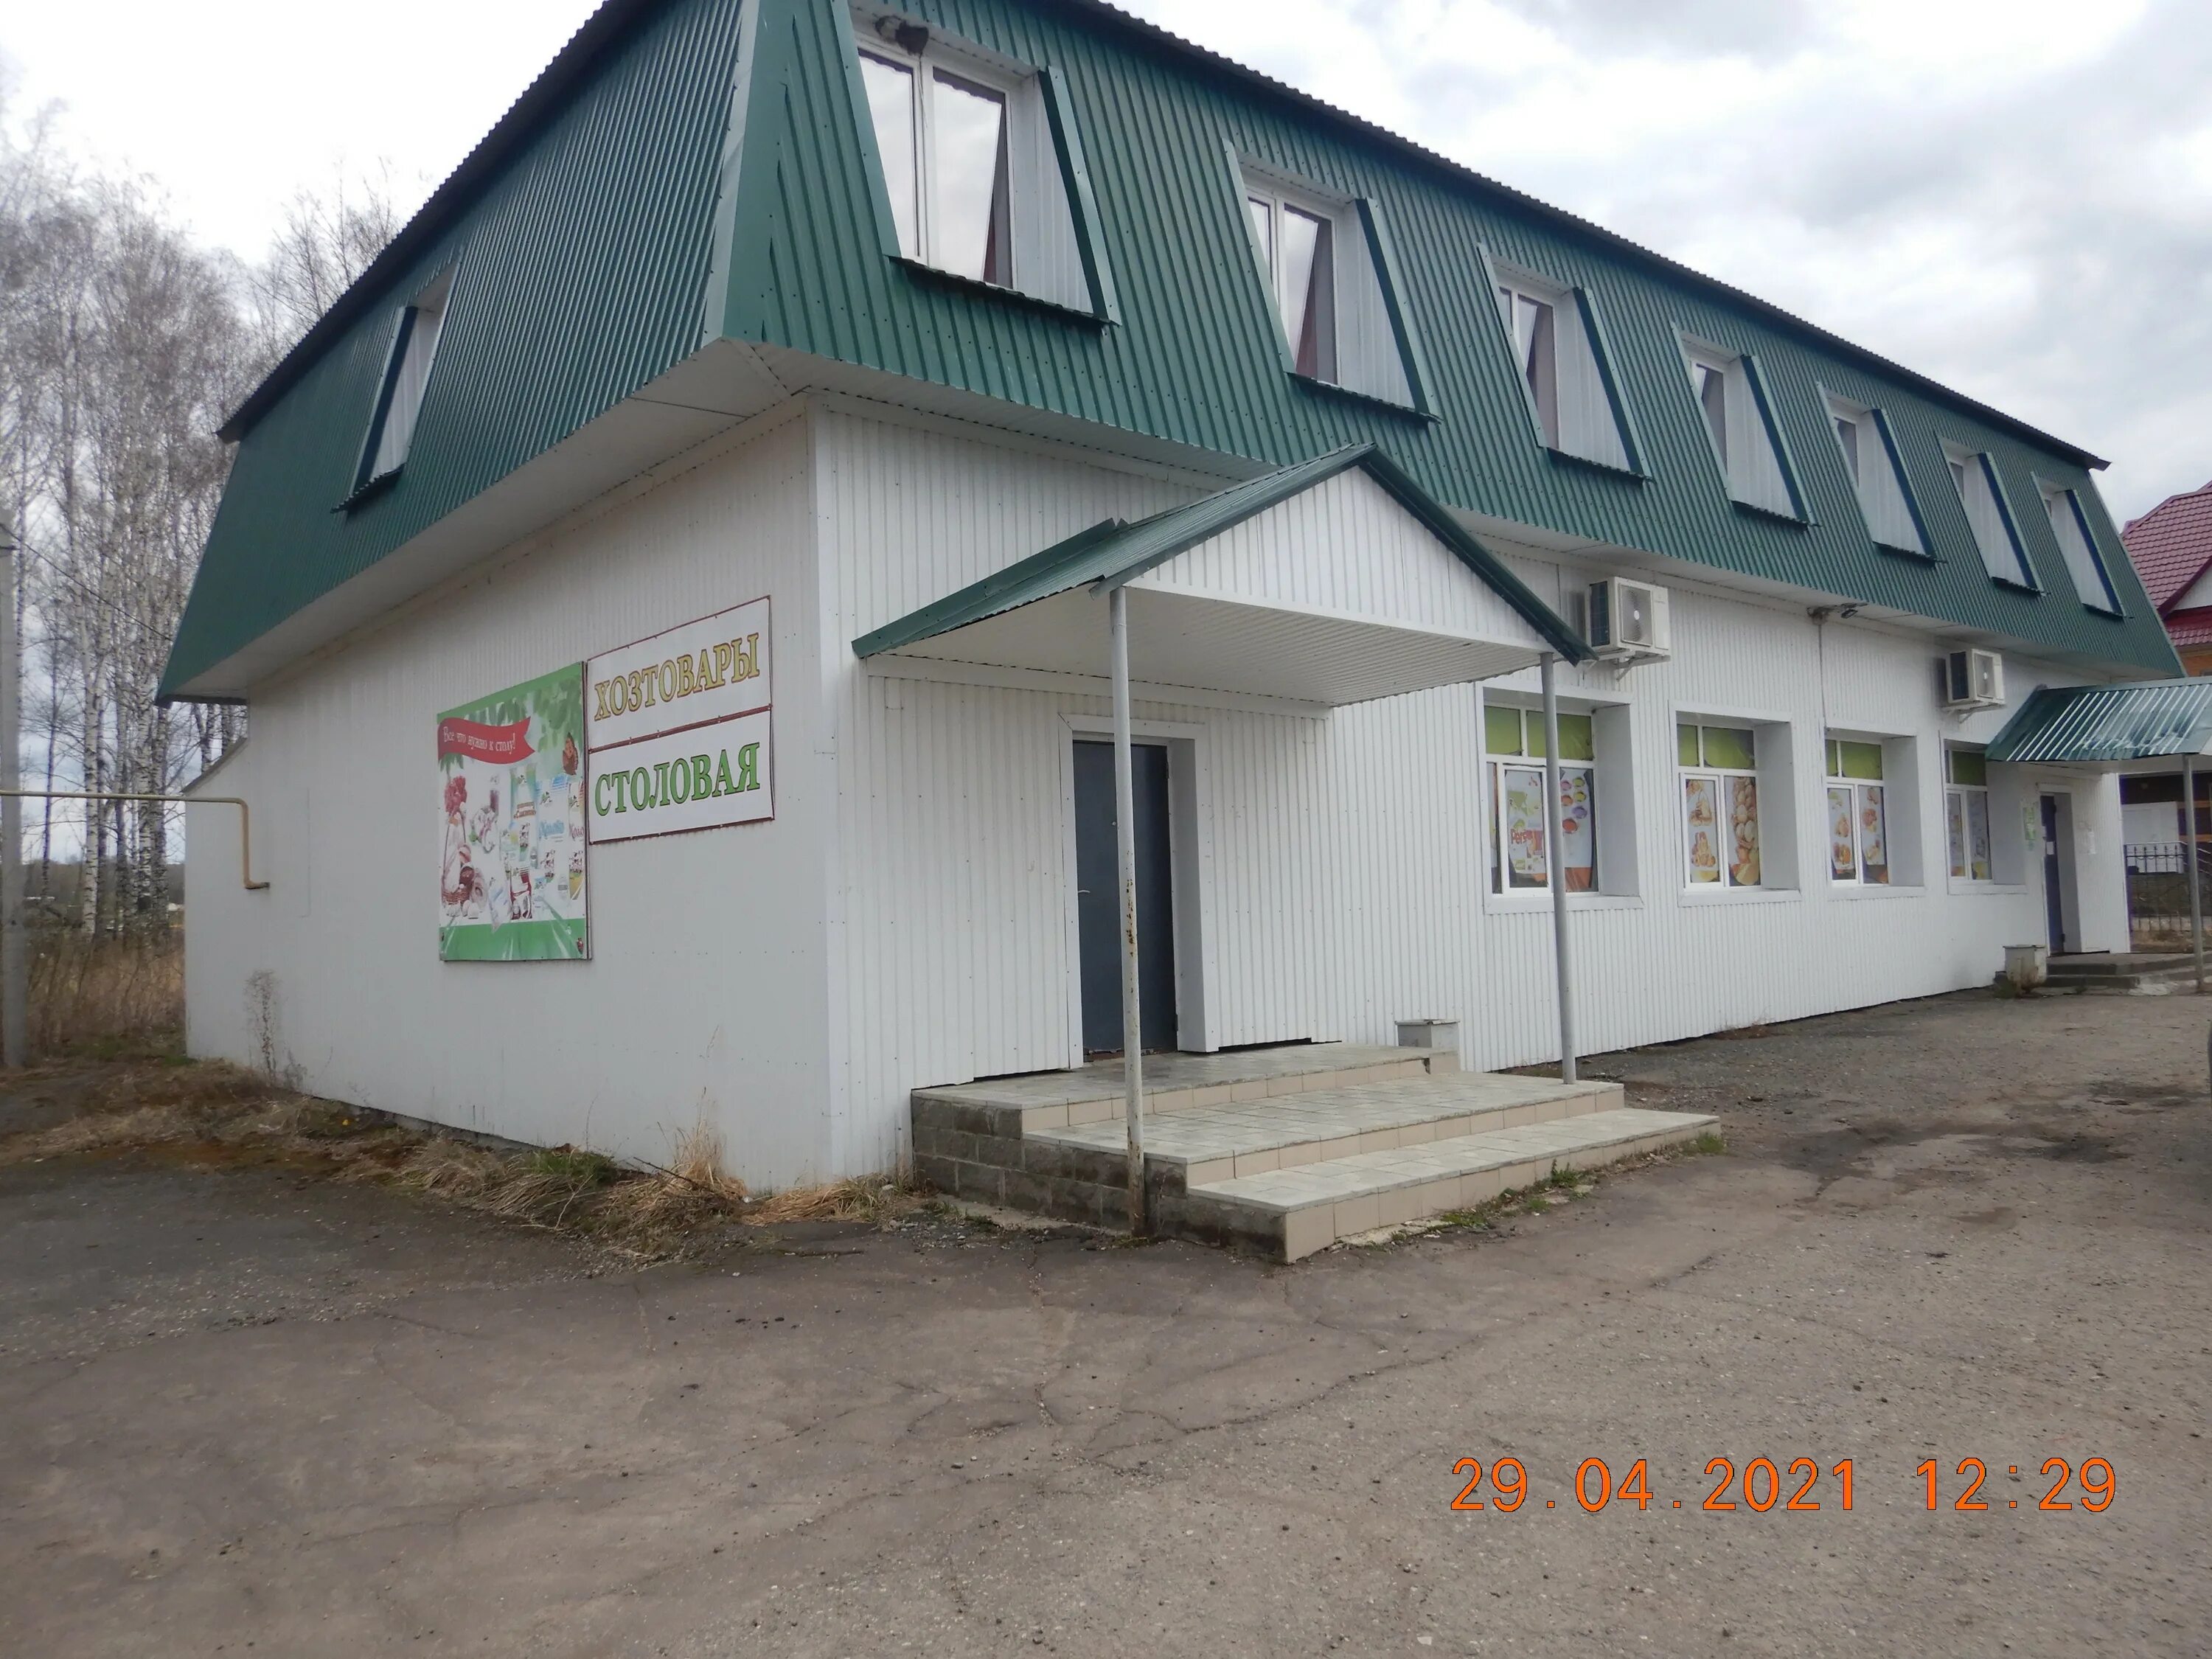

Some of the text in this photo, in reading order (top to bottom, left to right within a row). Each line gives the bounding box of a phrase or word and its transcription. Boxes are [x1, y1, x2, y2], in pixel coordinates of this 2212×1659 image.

[594, 633, 760, 721] ХОЗТОВАРЫ
[443, 726, 455, 742] Все
[595, 742, 760, 816] СТОЛОВАЯ
